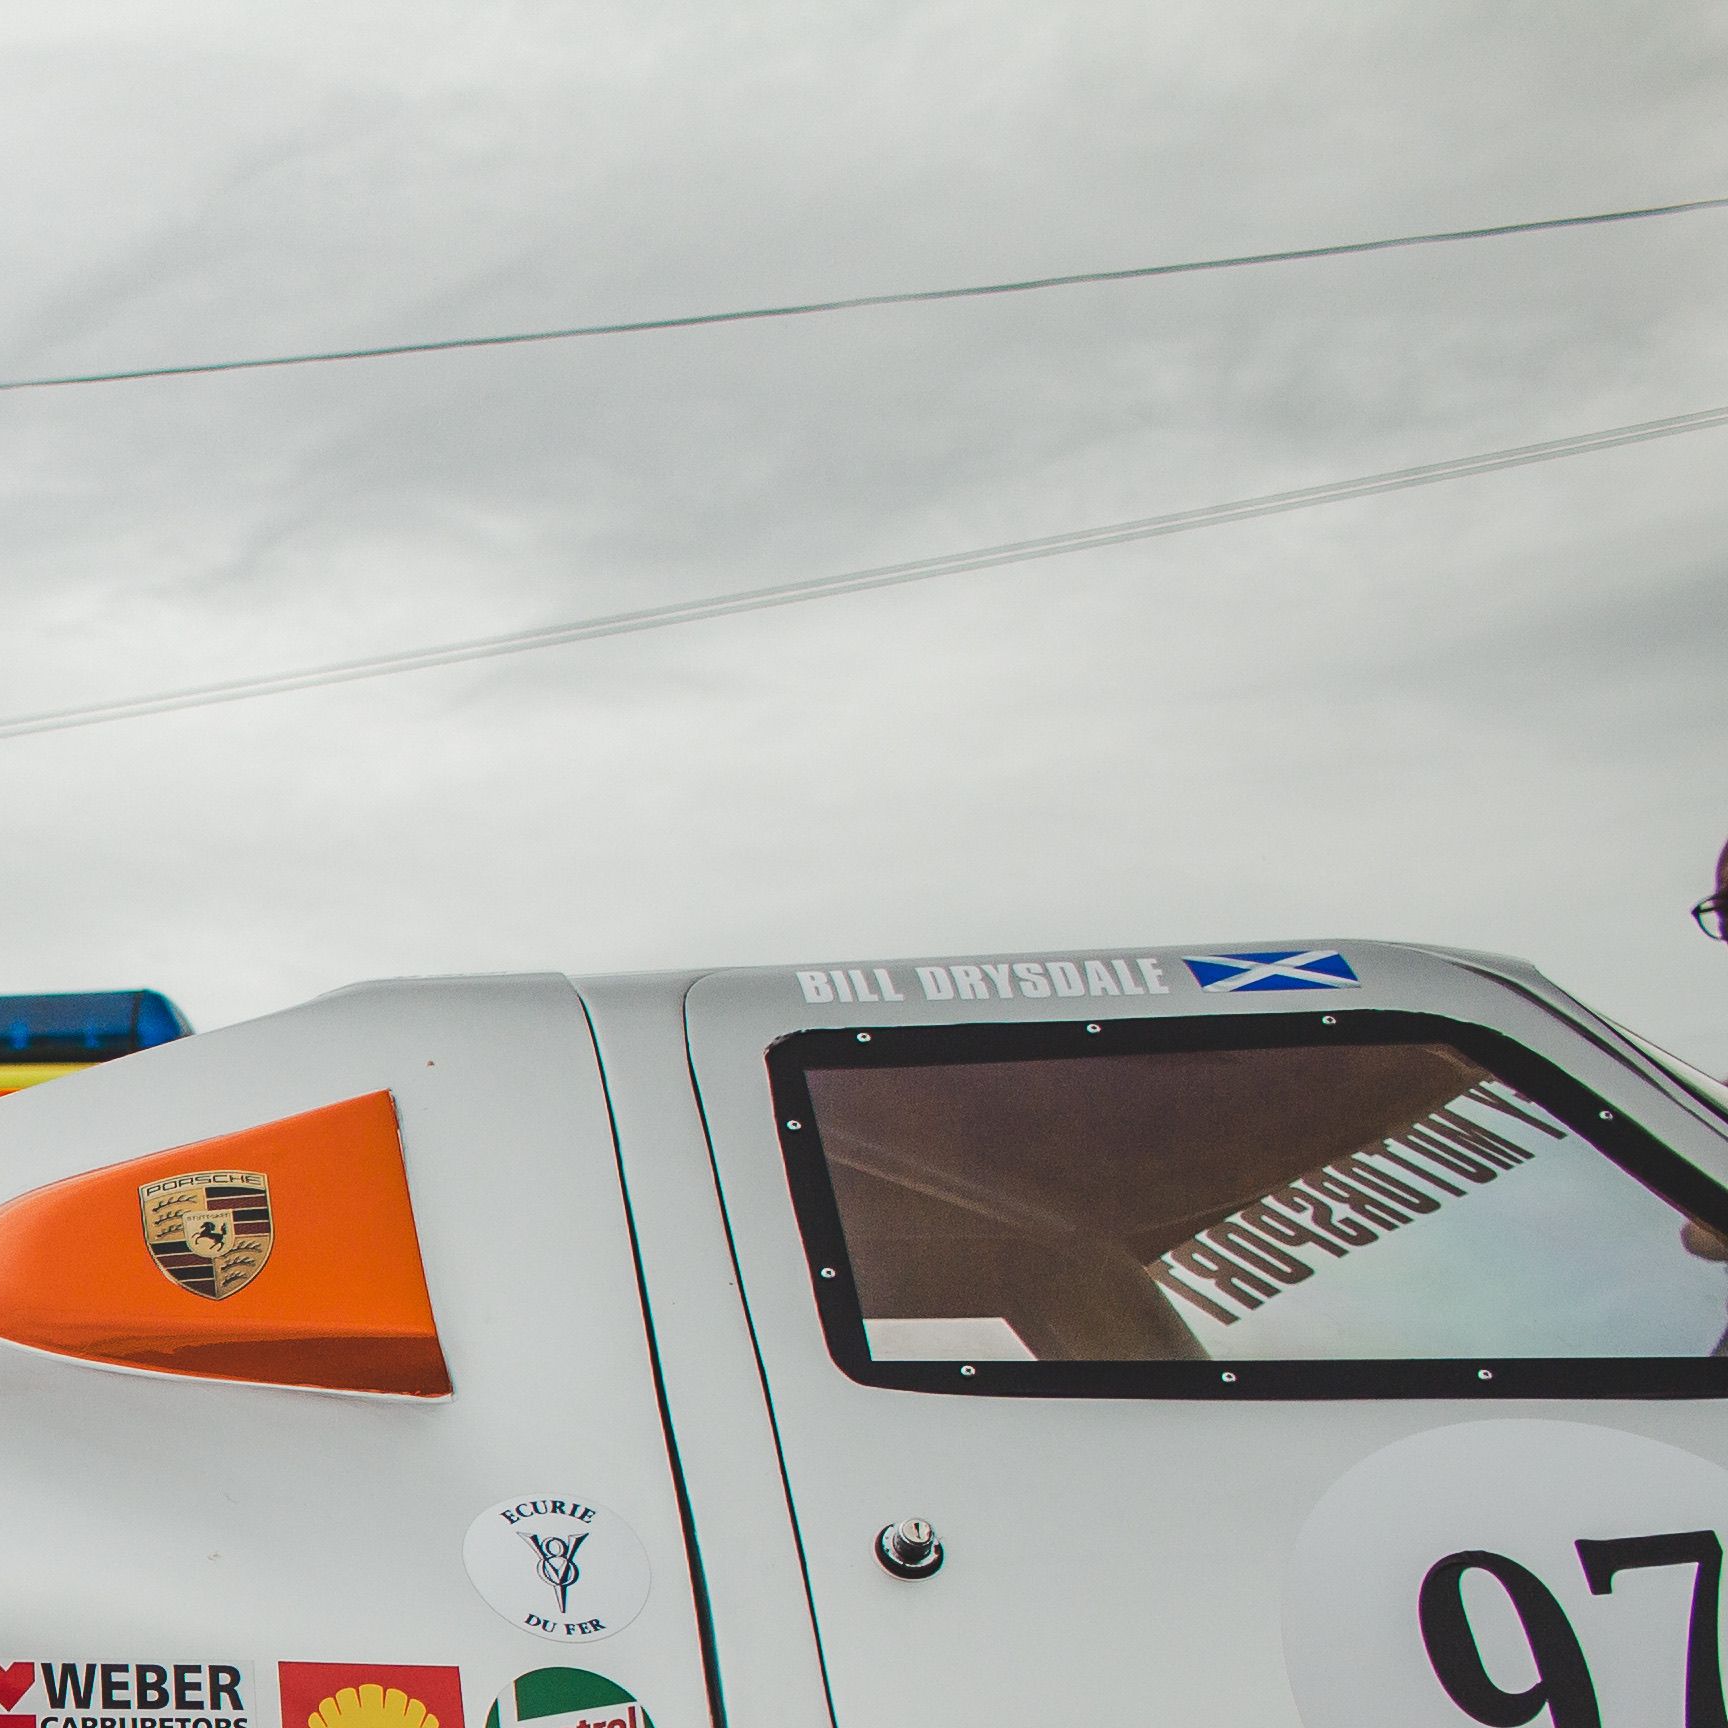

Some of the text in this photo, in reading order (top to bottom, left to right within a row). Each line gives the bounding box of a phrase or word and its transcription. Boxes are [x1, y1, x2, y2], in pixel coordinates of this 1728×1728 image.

[796, 958, 1170, 1004] BILL DRYSDALE
[146, 1174, 262, 1197] PORSCHE
[500, 1499, 597, 1525] ECURIE
[524, 1613, 607, 1636] DU FER
[40, 1662, 245, 1710] WEBER
